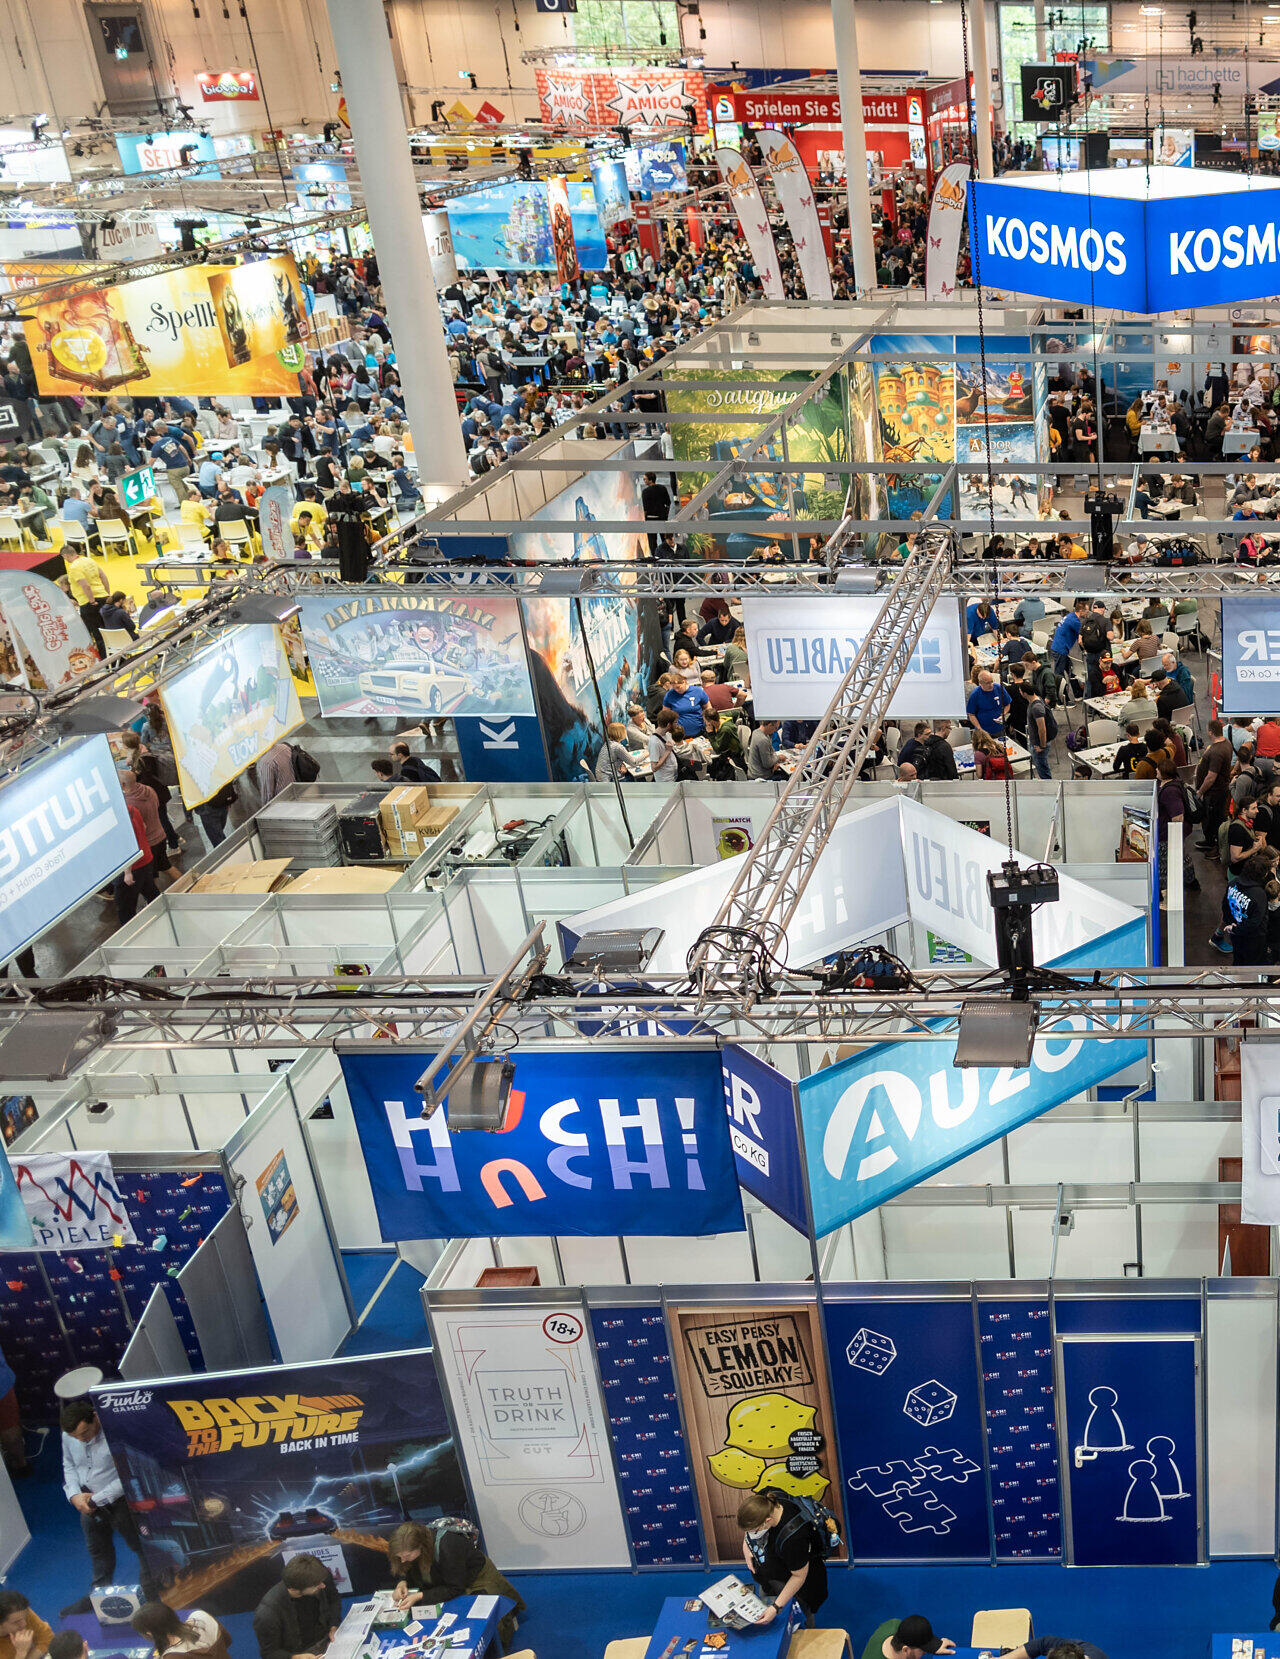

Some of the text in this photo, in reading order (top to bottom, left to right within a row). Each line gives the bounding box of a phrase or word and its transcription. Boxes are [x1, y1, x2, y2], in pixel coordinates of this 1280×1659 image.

[1178, 65, 1241, 82] hachette
[554, 96, 582, 110] AMIGO
[627, 96, 682, 110] AMIGO
[746, 100, 800, 119] Spielen
[805, 101, 829, 116] Sie
[986, 215, 1127, 276] KOSMOS
[734, 1135, 767, 1168] Co KG
[550, 1320, 577, 1336] 18+
[705, 1323, 780, 1346] EASY PEASY
[699, 1336, 799, 1375] LEMON
[719, 1365, 794, 1390] SQUEAKY
[98, 1390, 151, 1408] Funko
[488, 1386, 562, 1401] TRUTH
[112, 1404, 147, 1413] GAMES
[167, 1394, 334, 1432] BACK
[494, 1407, 566, 1423] DRINK
[187, 1429, 218, 1444] TO
[218, 1409, 364, 1453] FUTURE
[187, 1443, 220, 1457] THE
[280, 1432, 359, 1454] BACK IN TIME
